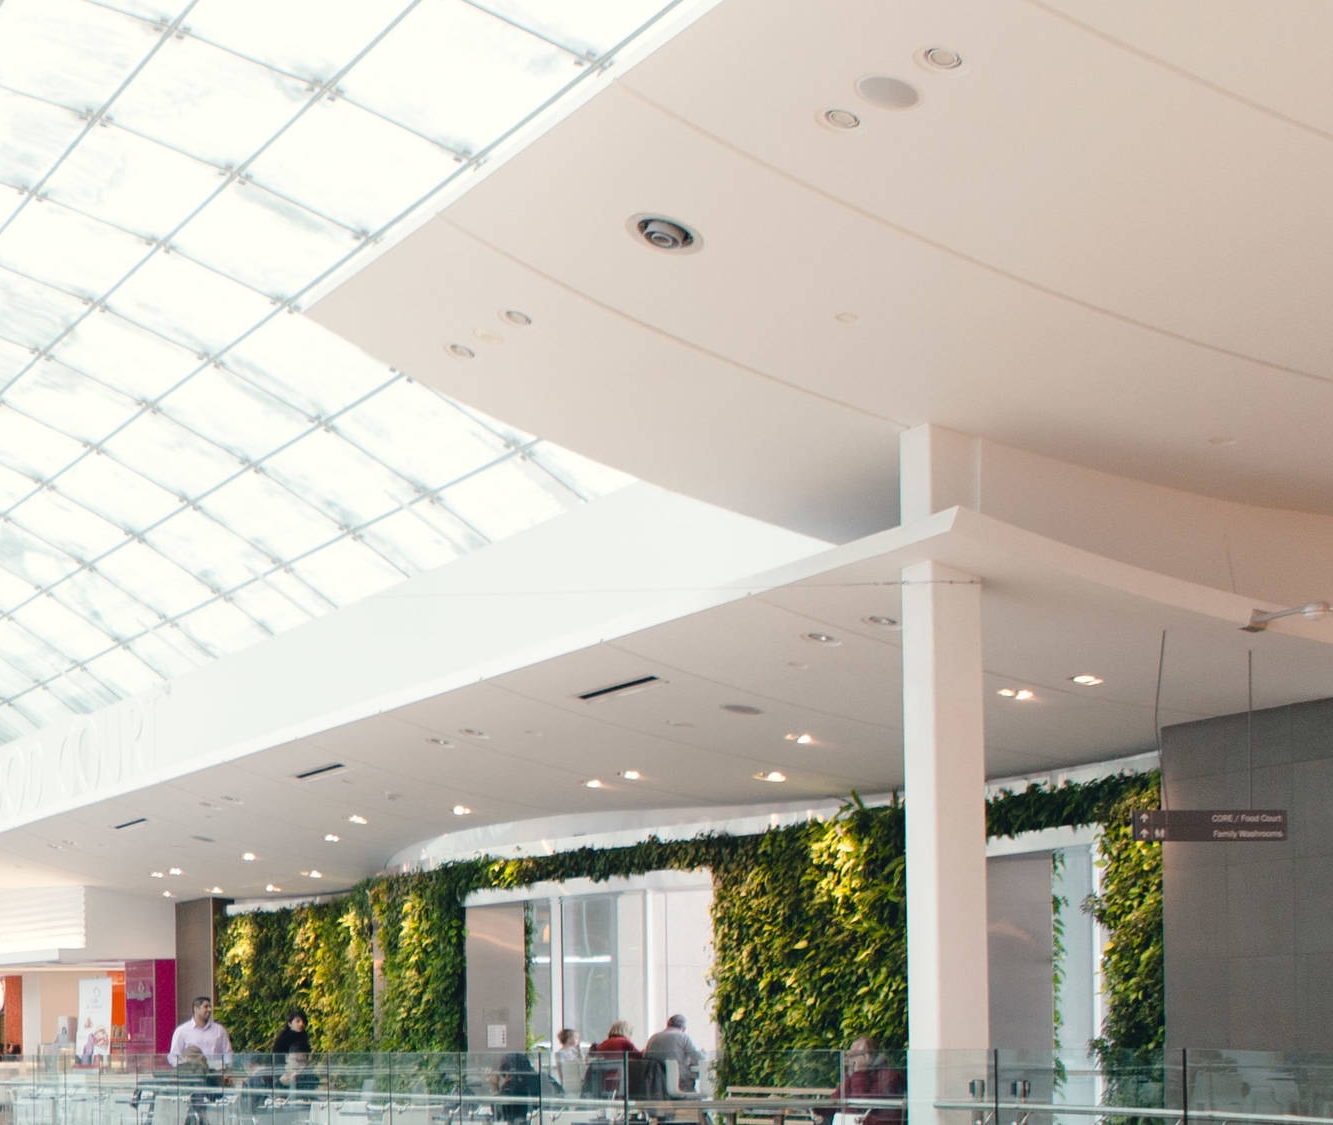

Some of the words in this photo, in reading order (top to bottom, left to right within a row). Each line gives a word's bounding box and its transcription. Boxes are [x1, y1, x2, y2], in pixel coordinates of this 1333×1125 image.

[1241, 814, 1260, 823] Food
[1261, 814, 1282, 823] Court
[1212, 830, 1237, 839] Family
[1238, 830, 1284, 839] Washrooms
